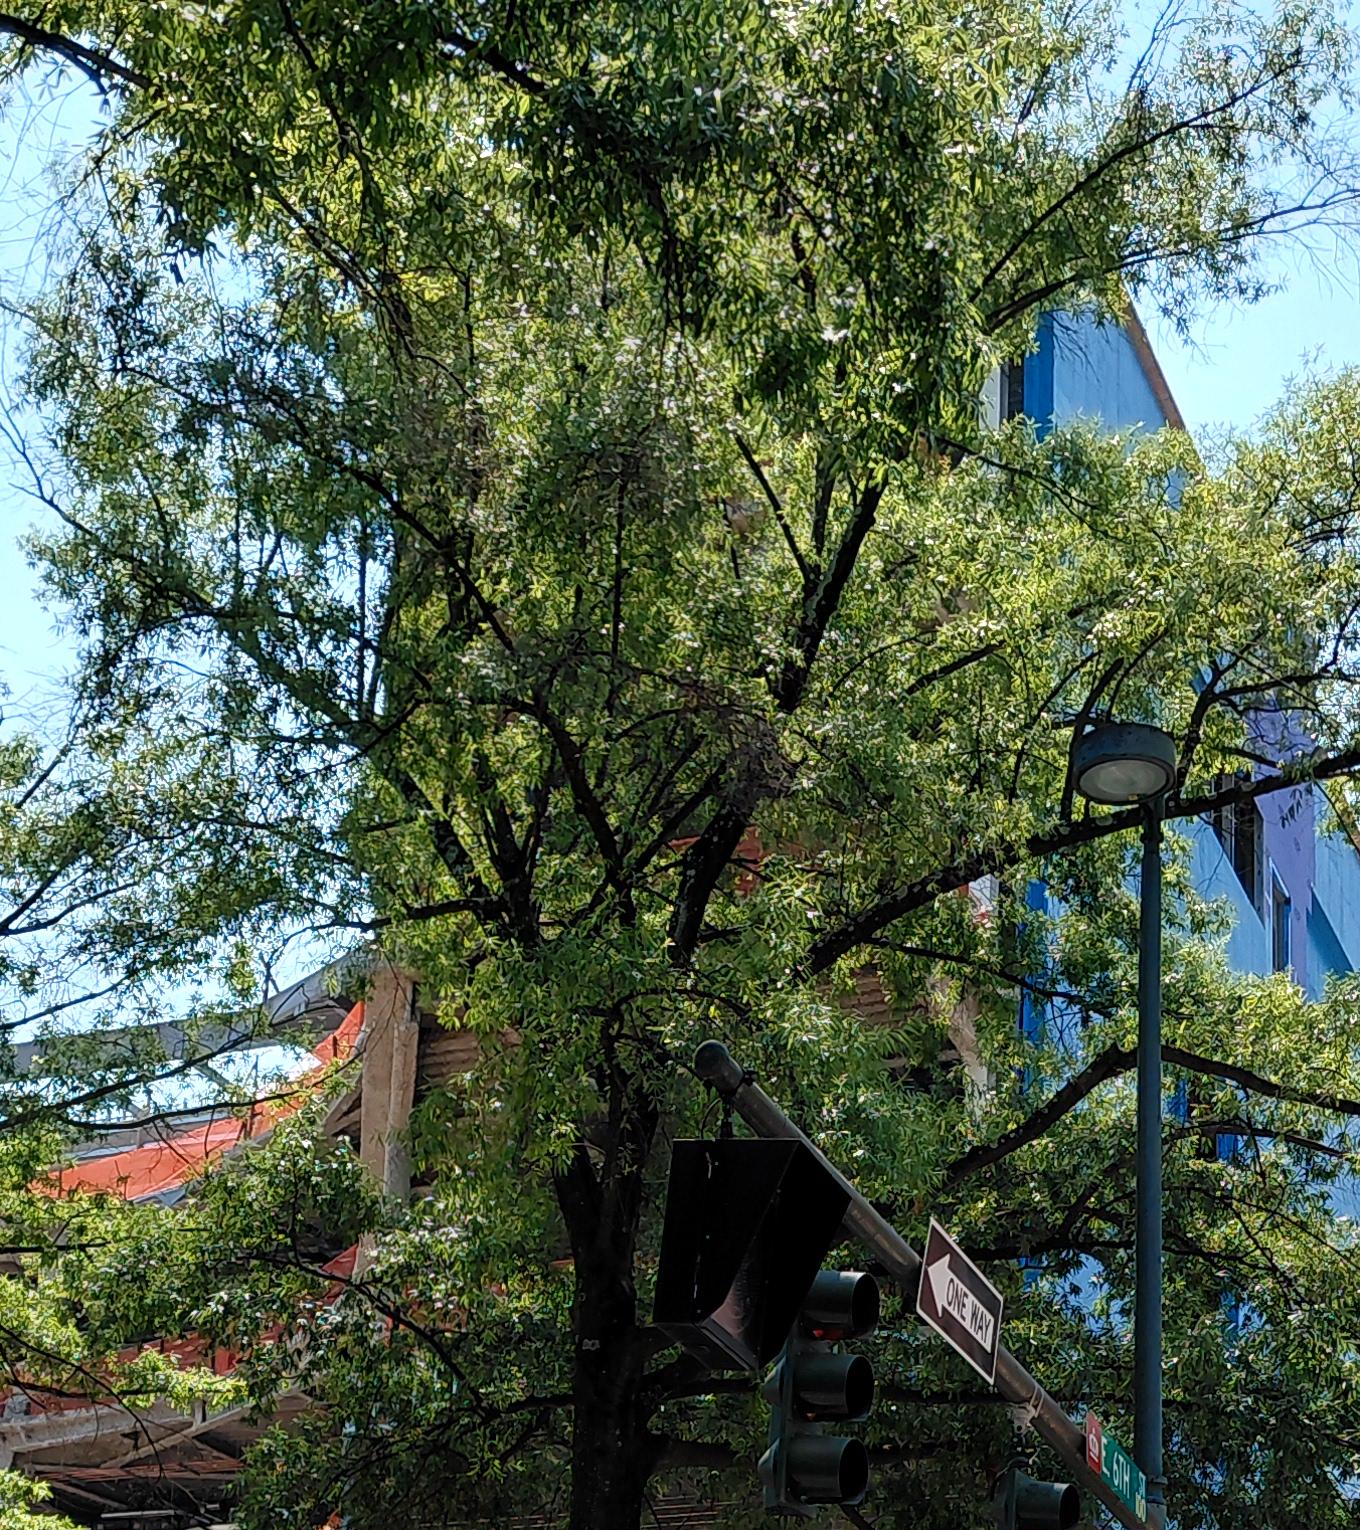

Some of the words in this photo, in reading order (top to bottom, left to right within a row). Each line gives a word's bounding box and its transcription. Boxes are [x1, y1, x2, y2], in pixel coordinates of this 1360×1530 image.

[946, 1277, 969, 1323] ONE
[970, 1299, 992, 1344] WAY
[1112, 1451, 1130, 1499] 6TH
